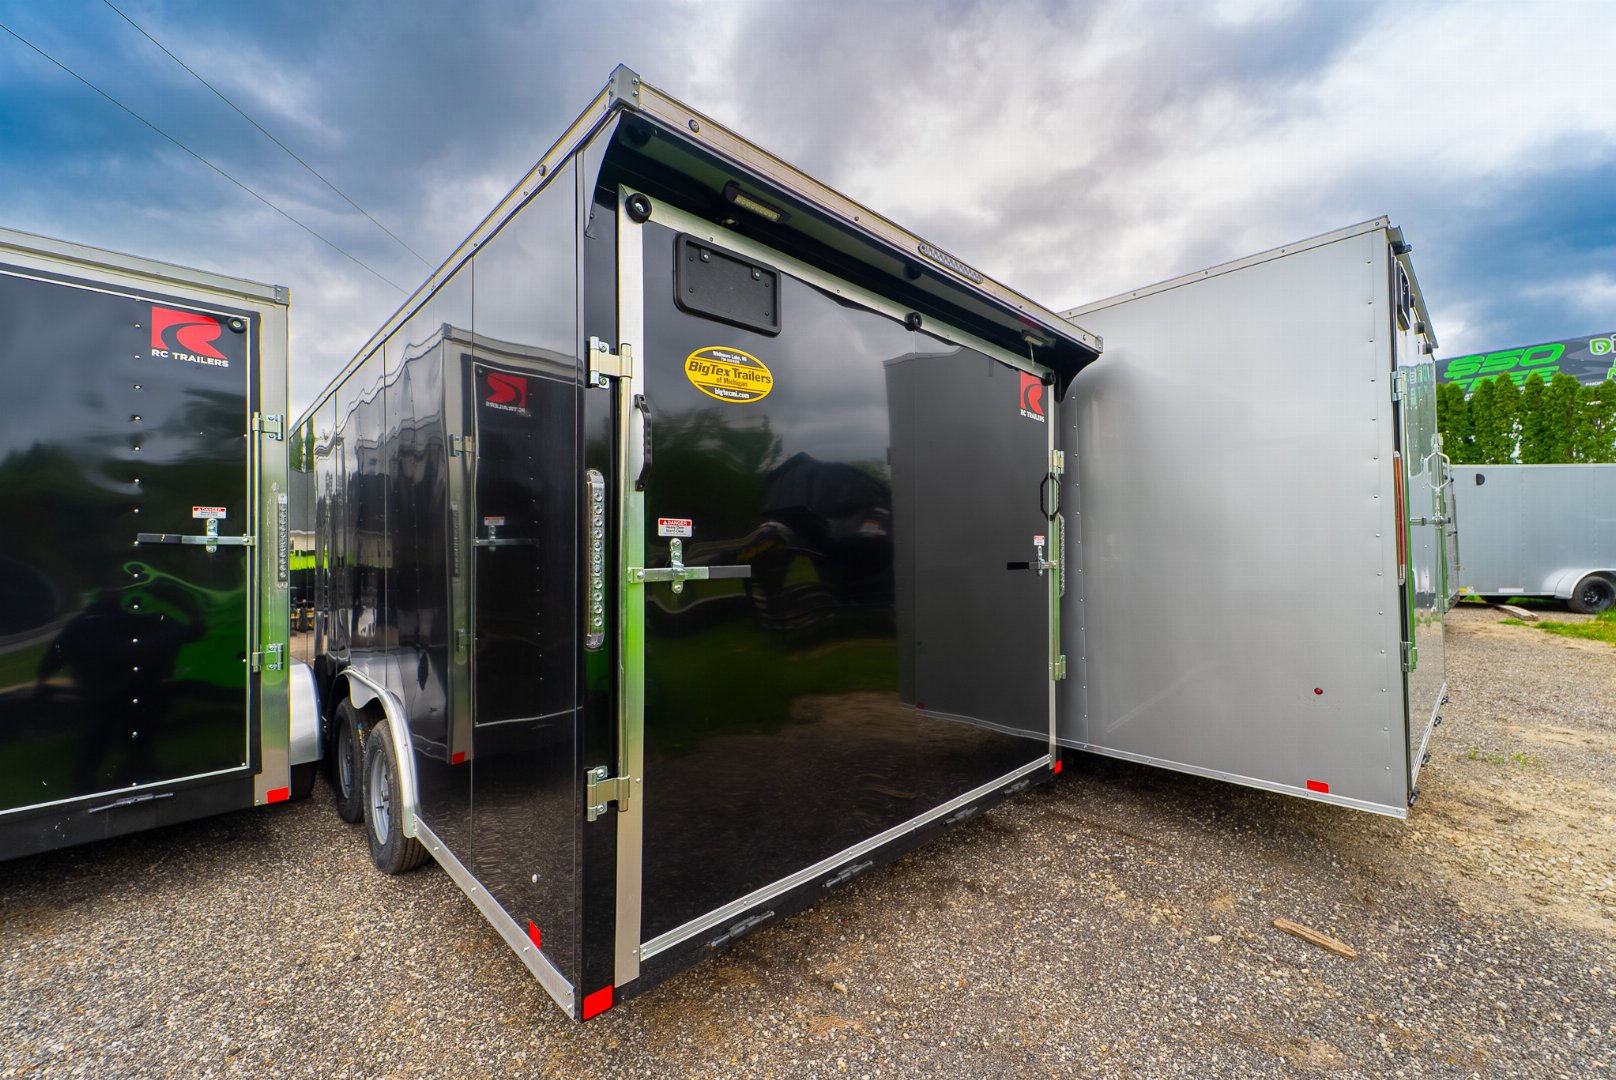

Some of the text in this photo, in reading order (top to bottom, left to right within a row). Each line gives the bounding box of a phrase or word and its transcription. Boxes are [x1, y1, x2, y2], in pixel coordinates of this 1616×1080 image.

[151, 348, 229, 368] RC TRAILERS
[688, 360, 730, 377] BigTex
[732, 367, 772, 384] Trailers
[723, 378, 748, 388] Michigan
[1020, 409, 1045, 423] RC TRAILERS
